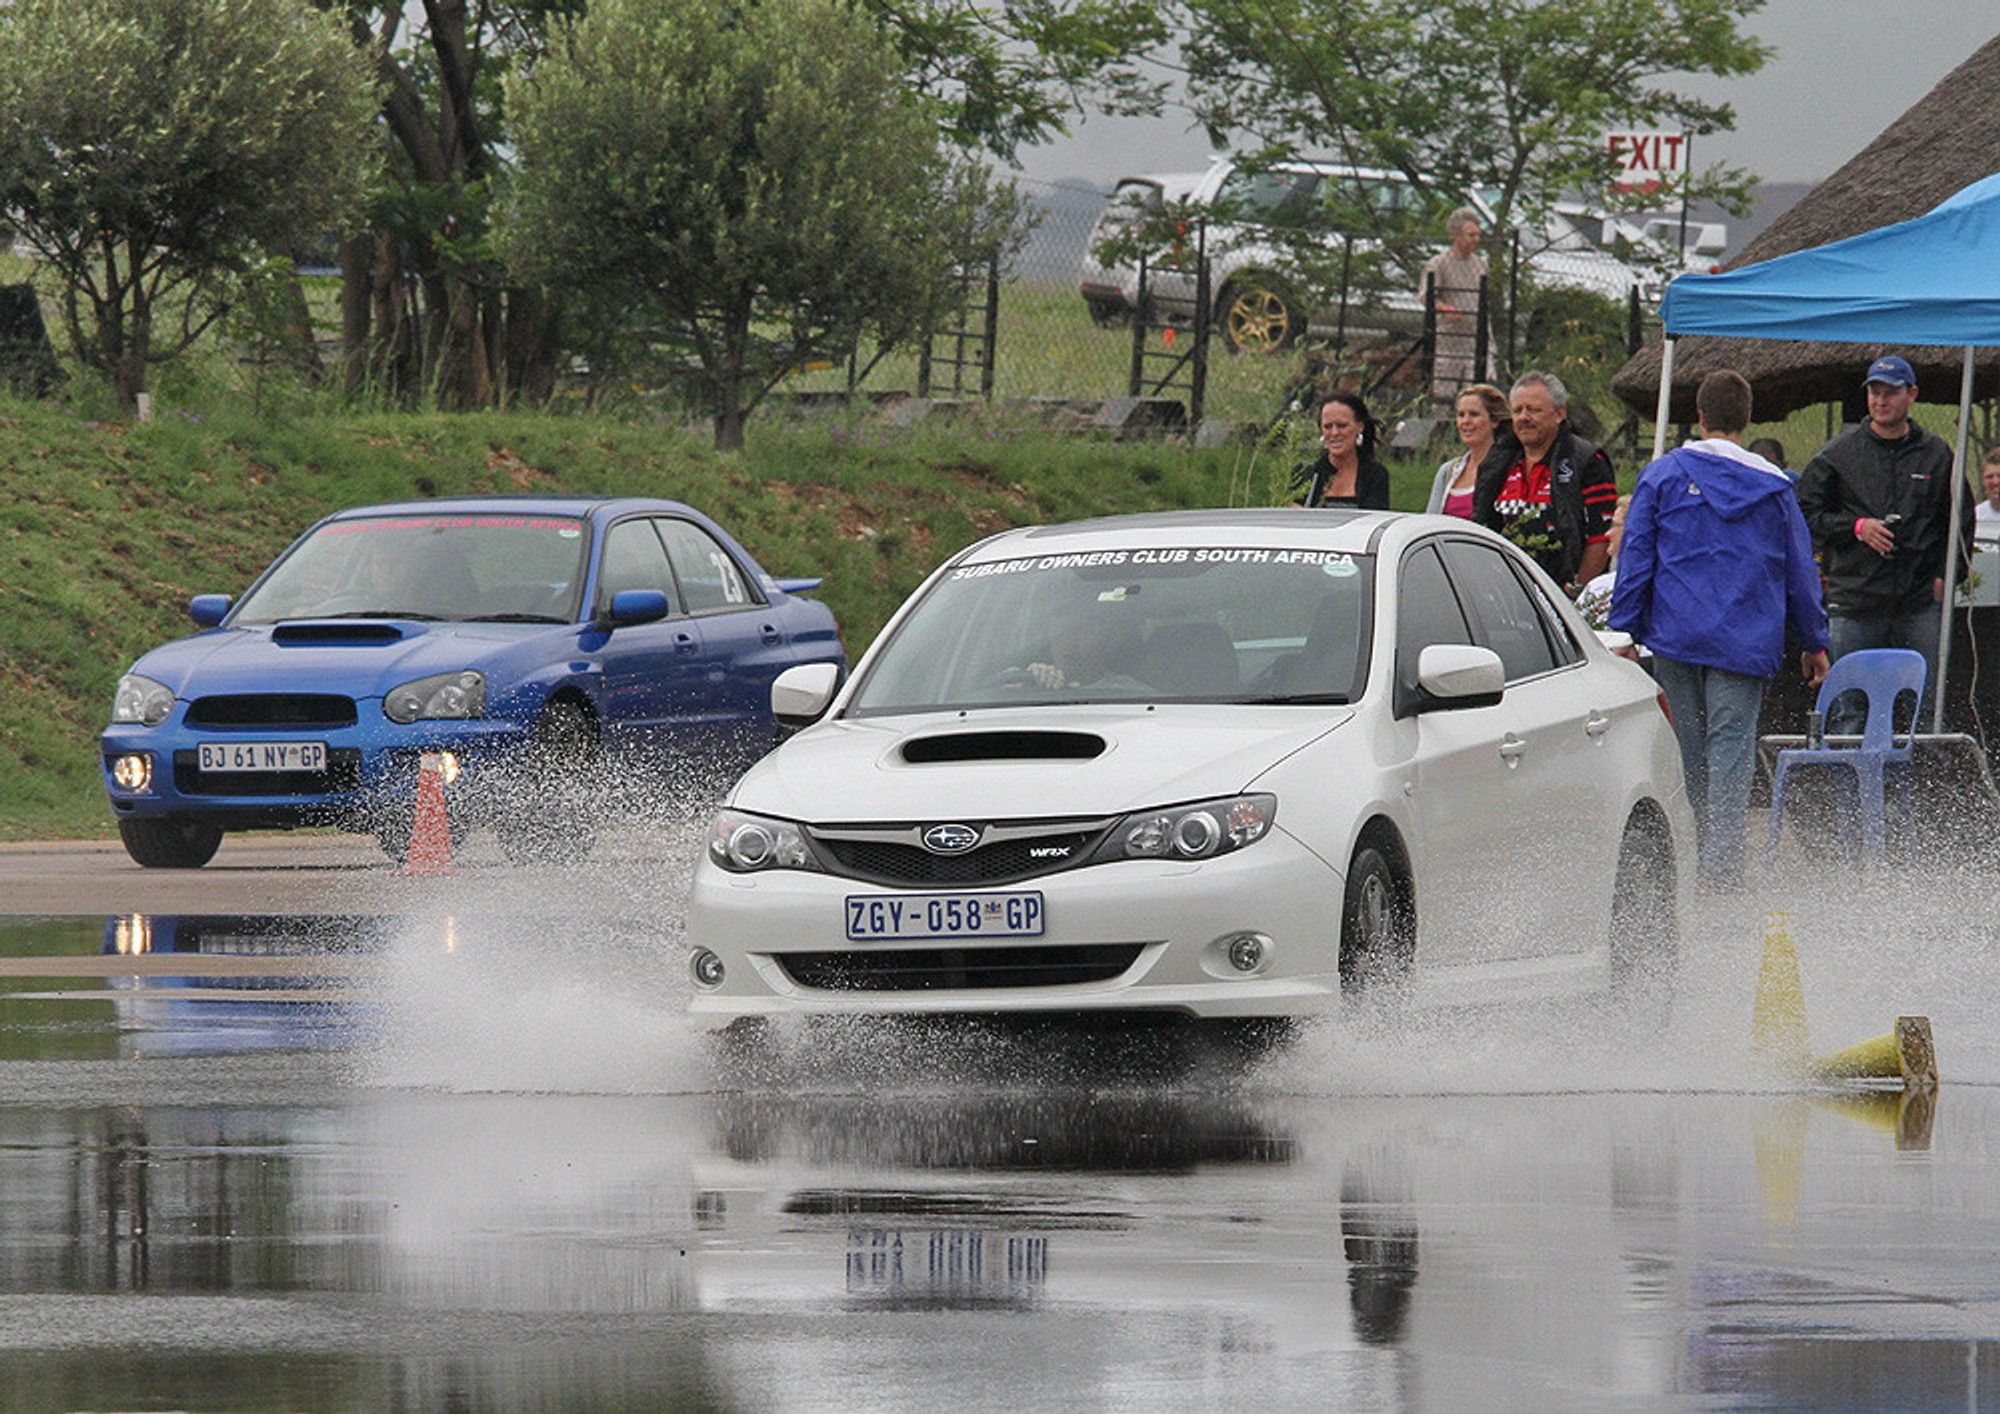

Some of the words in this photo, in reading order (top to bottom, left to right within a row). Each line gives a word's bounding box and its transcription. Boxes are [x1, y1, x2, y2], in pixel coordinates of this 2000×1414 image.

[1608, 135, 1684, 171] EXIT
[952, 558, 1037, 580] SUBARU
[1038, 552, 1129, 570] OWNERS
[1132, 550, 1189, 564] CLUB
[1194, 549, 1270, 563] SOUTH
[1274, 551, 1355, 566] AFRICA
[202, 746, 226, 768] BJ
[234, 746, 256, 768] 61
[264, 746, 287, 767] NY
[301, 745, 322, 767] GP
[1030, 846, 1071, 858] WRX
[1007, 898, 1039, 930] GP
